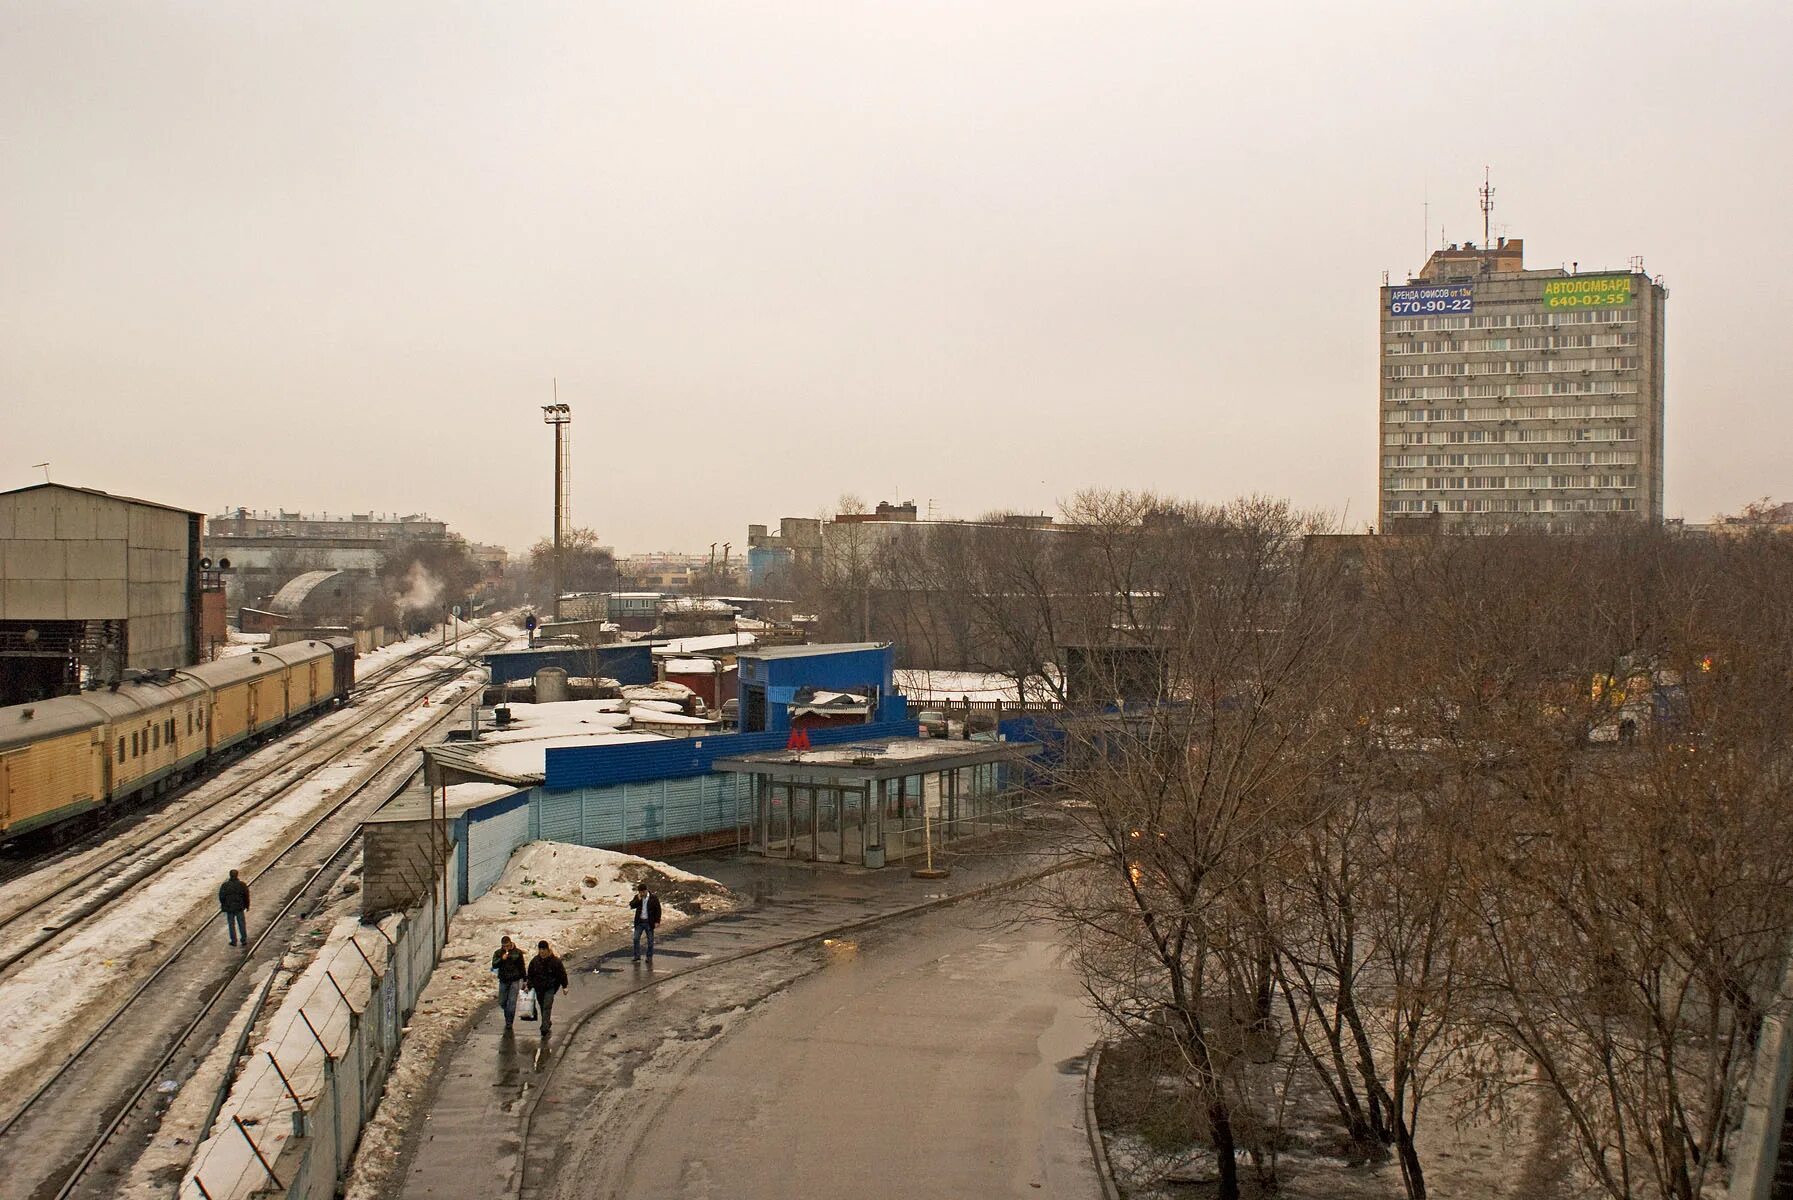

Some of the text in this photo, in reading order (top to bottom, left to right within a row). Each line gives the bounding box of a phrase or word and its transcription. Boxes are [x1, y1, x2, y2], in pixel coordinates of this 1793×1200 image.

[1545, 279, 1631, 294] АВТОЛОМБАРД
[1392, 291, 1420, 301] АРЕНДА
[1420, 289, 1449, 299] ОФИСОВ
[1550, 294, 1625, 306] 640-02-55
[1392, 300, 1472, 313] 670-90-22
